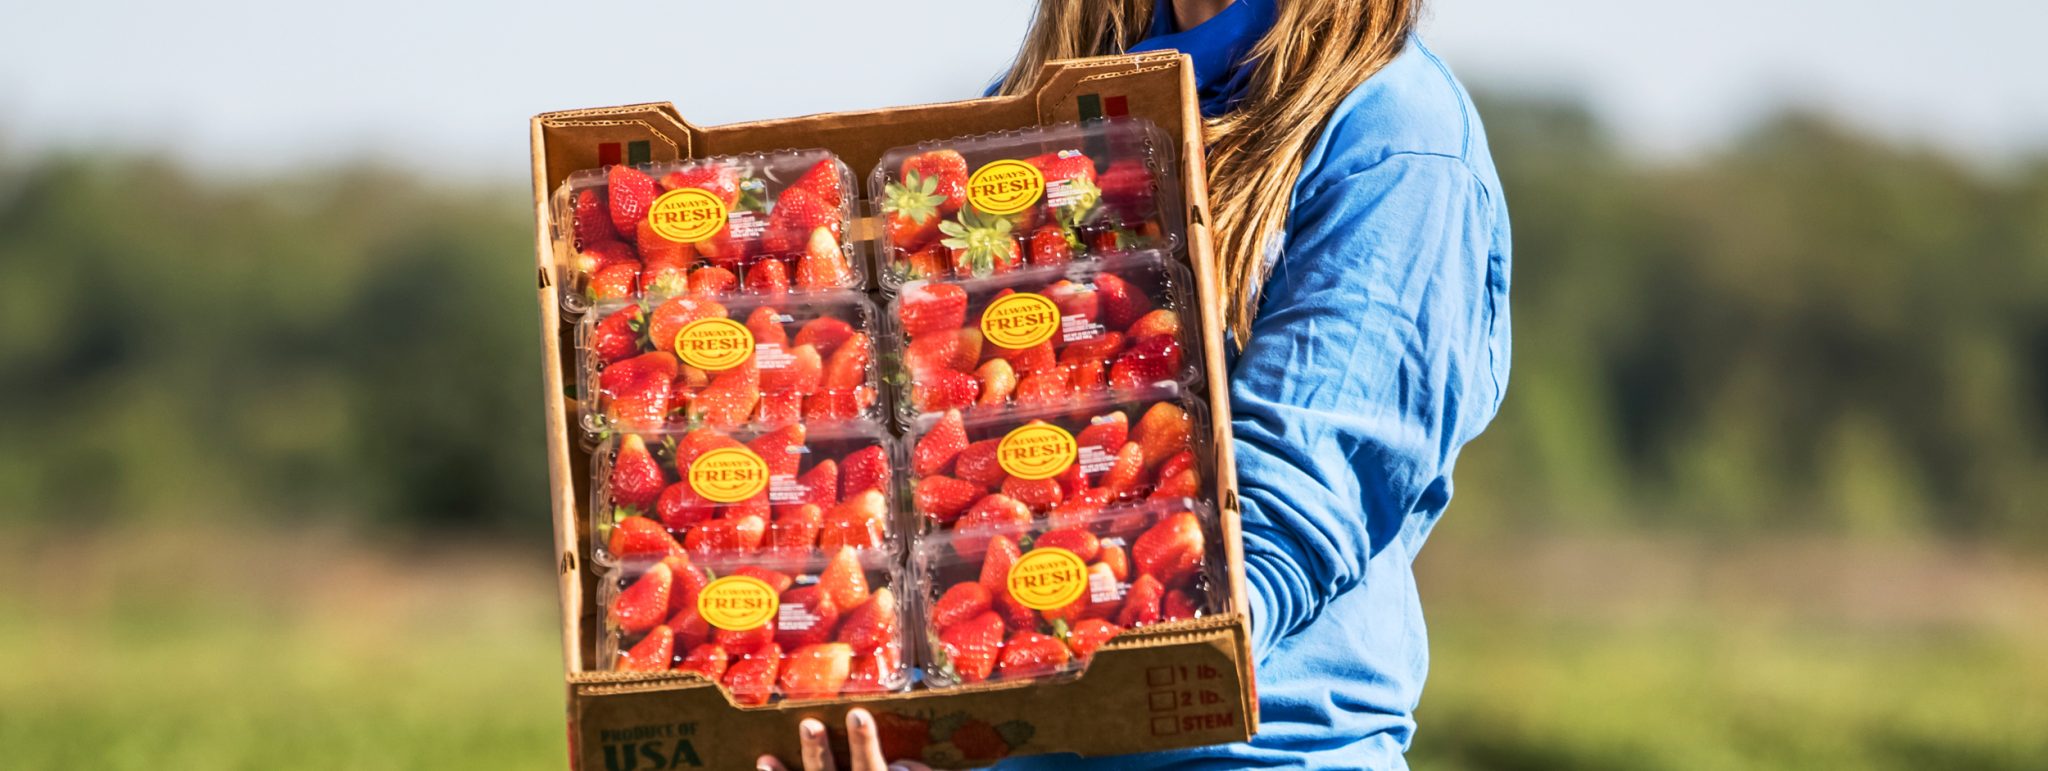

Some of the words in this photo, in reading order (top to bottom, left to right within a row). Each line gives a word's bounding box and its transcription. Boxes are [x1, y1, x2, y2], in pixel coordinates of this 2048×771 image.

[980, 171, 1026, 183] ALWAYS
[970, 178, 1039, 198] FRESH
[663, 199, 709, 209] ALWAYS
[652, 207, 721, 224] FRESH
[995, 304, 1042, 316] ALWAYS
[985, 311, 1054, 331] FRESH
[689, 330, 737, 338] ALWAYS
[679, 338, 748, 351] FRESH
[1011, 435, 1058, 446] ALWAYS
[1002, 442, 1071, 461] FRESH
[694, 469, 763, 481] FRESH
[1022, 560, 1068, 573] ALWAYS
[1012, 569, 1081, 589] FRESH
[703, 598, 772, 609] FRESH
[1179, 666, 1188, 681] 1
[1197, 664, 1223, 680] lb.
[1181, 691, 1192, 706] 2
[1199, 690, 1225, 705] lb.
[1183, 711, 1234, 731] STEM
[678, 722, 698, 736] OF
[603, 739, 704, 771] USA
